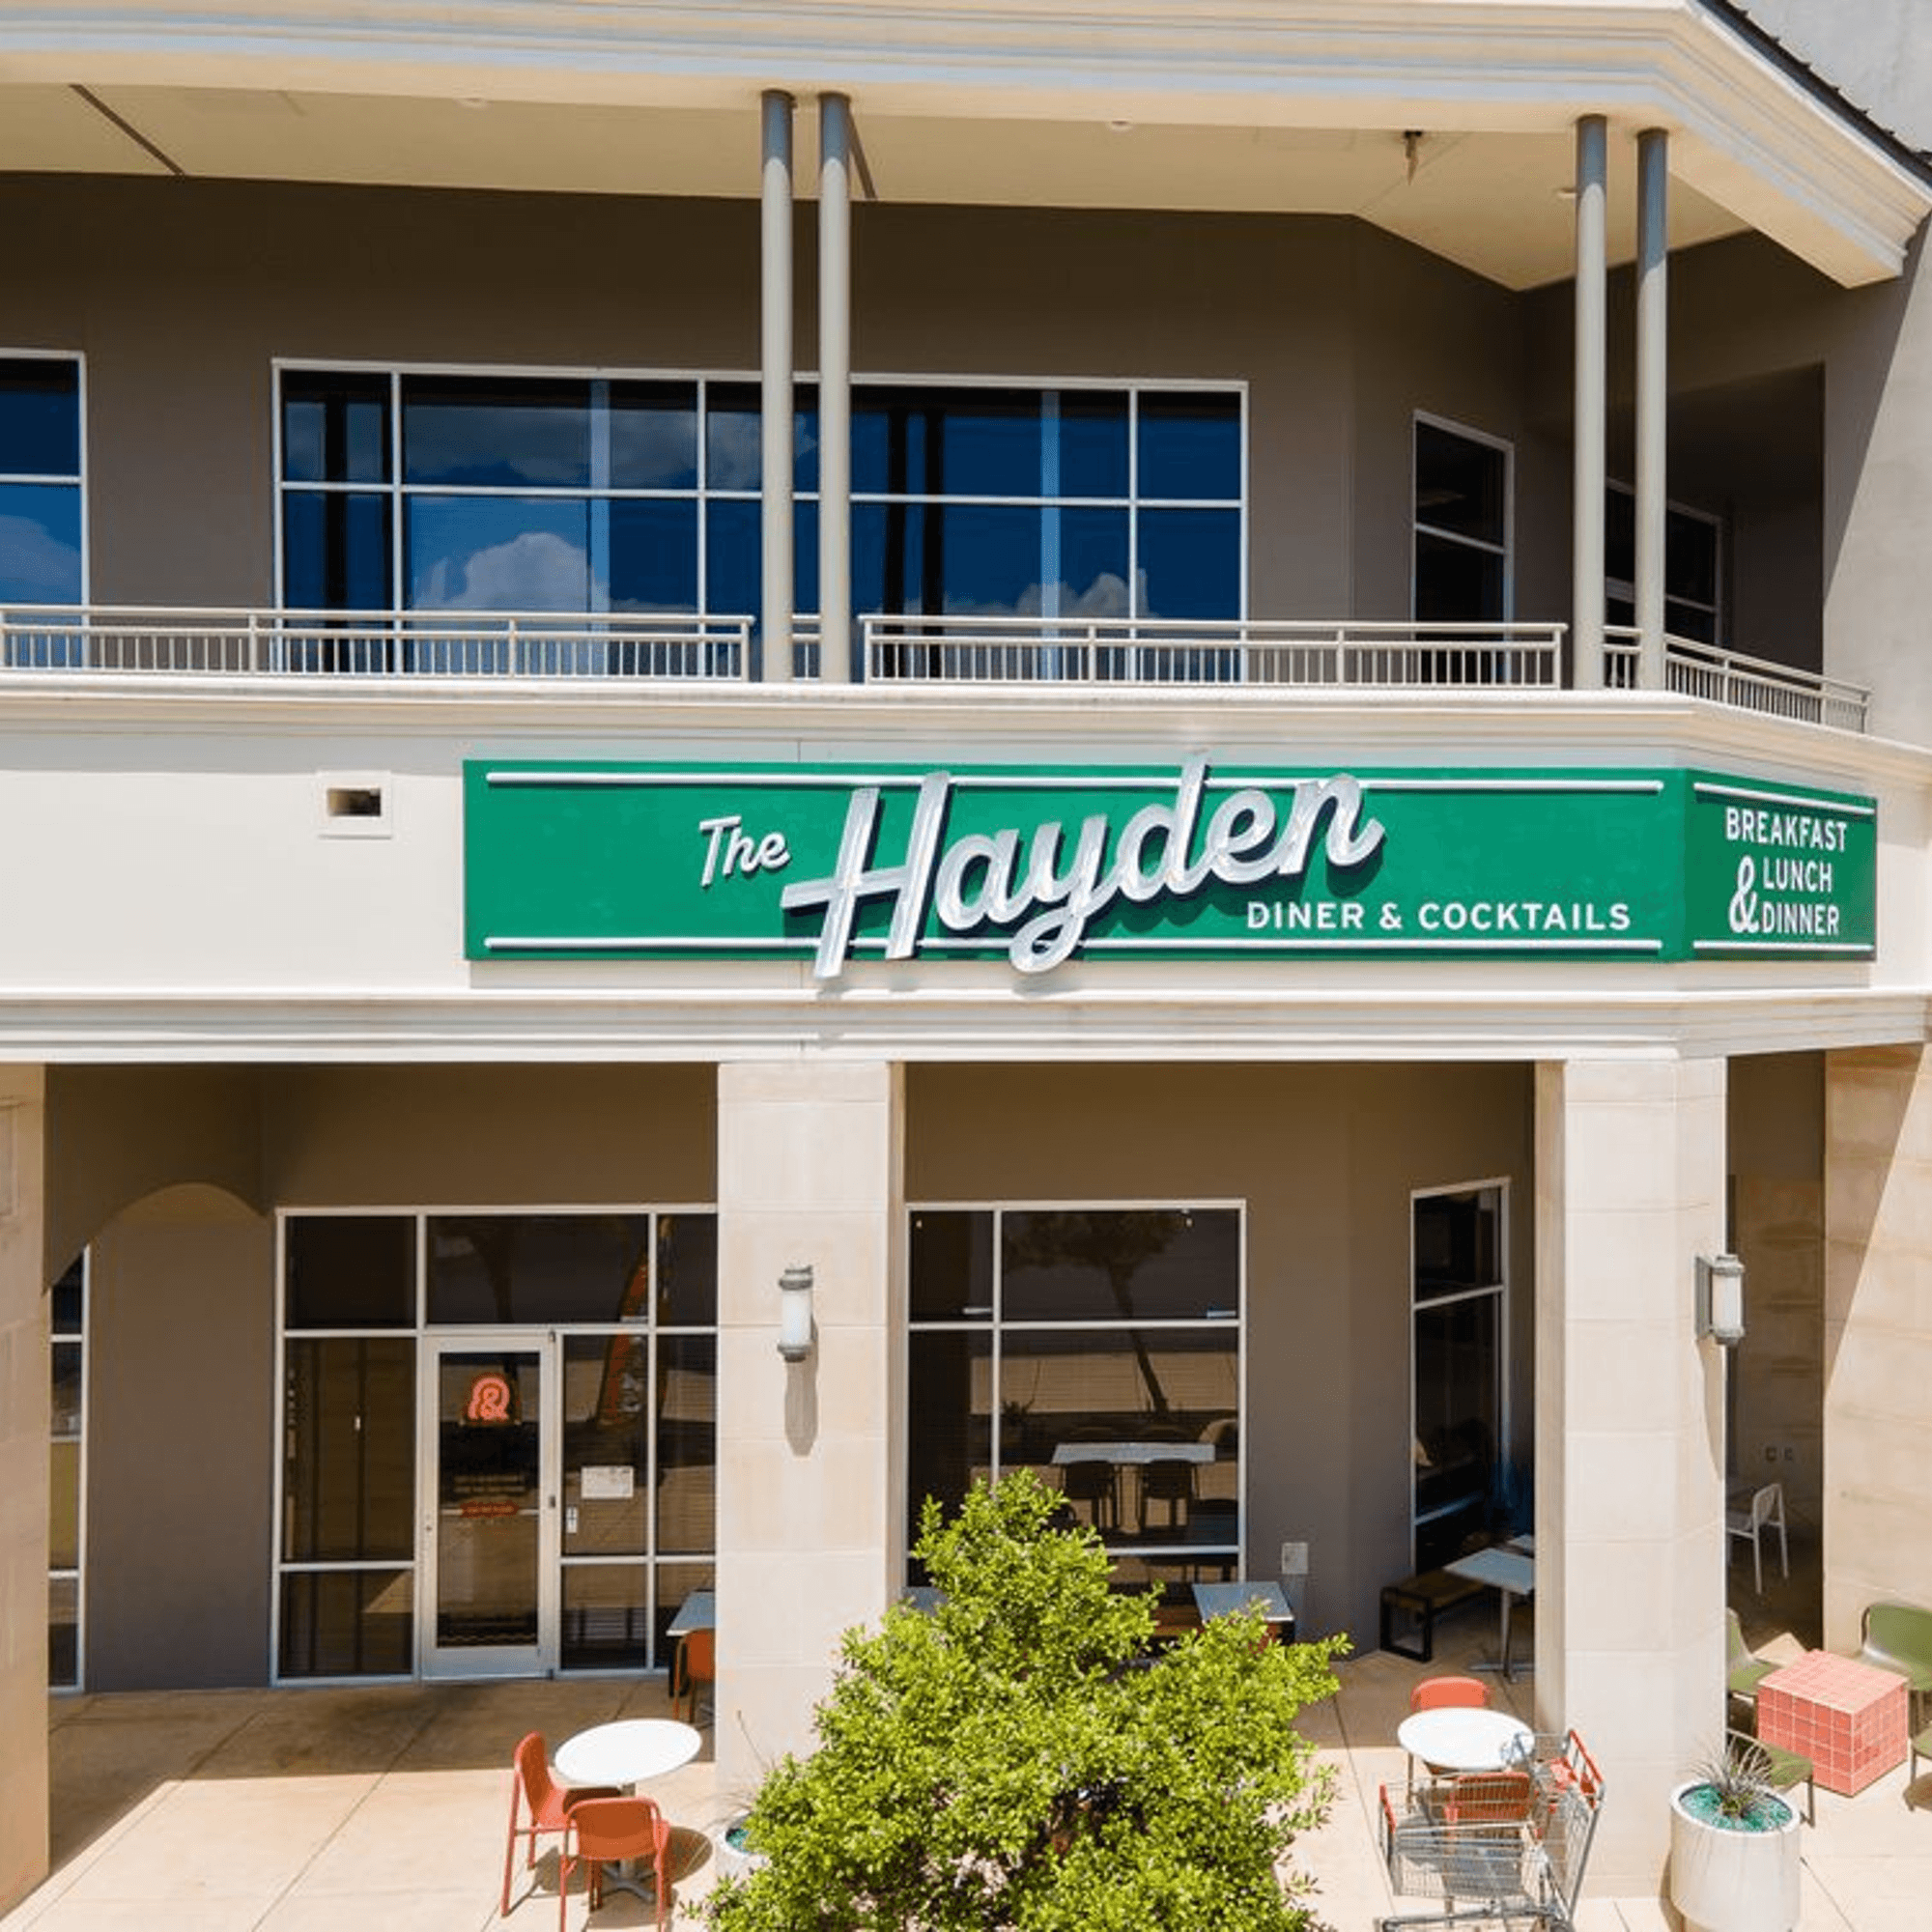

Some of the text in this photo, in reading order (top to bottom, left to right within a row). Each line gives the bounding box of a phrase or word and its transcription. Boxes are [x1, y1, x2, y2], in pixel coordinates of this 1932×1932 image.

[1725, 806, 1847, 852] BREAKFAST
[698, 751, 1385, 979] The Hayden
[1763, 856, 1833, 893] LUNCH
[1246, 901, 1631, 930] DINER & COCKTAILS
[1728, 855, 1839, 935] & DINNER
